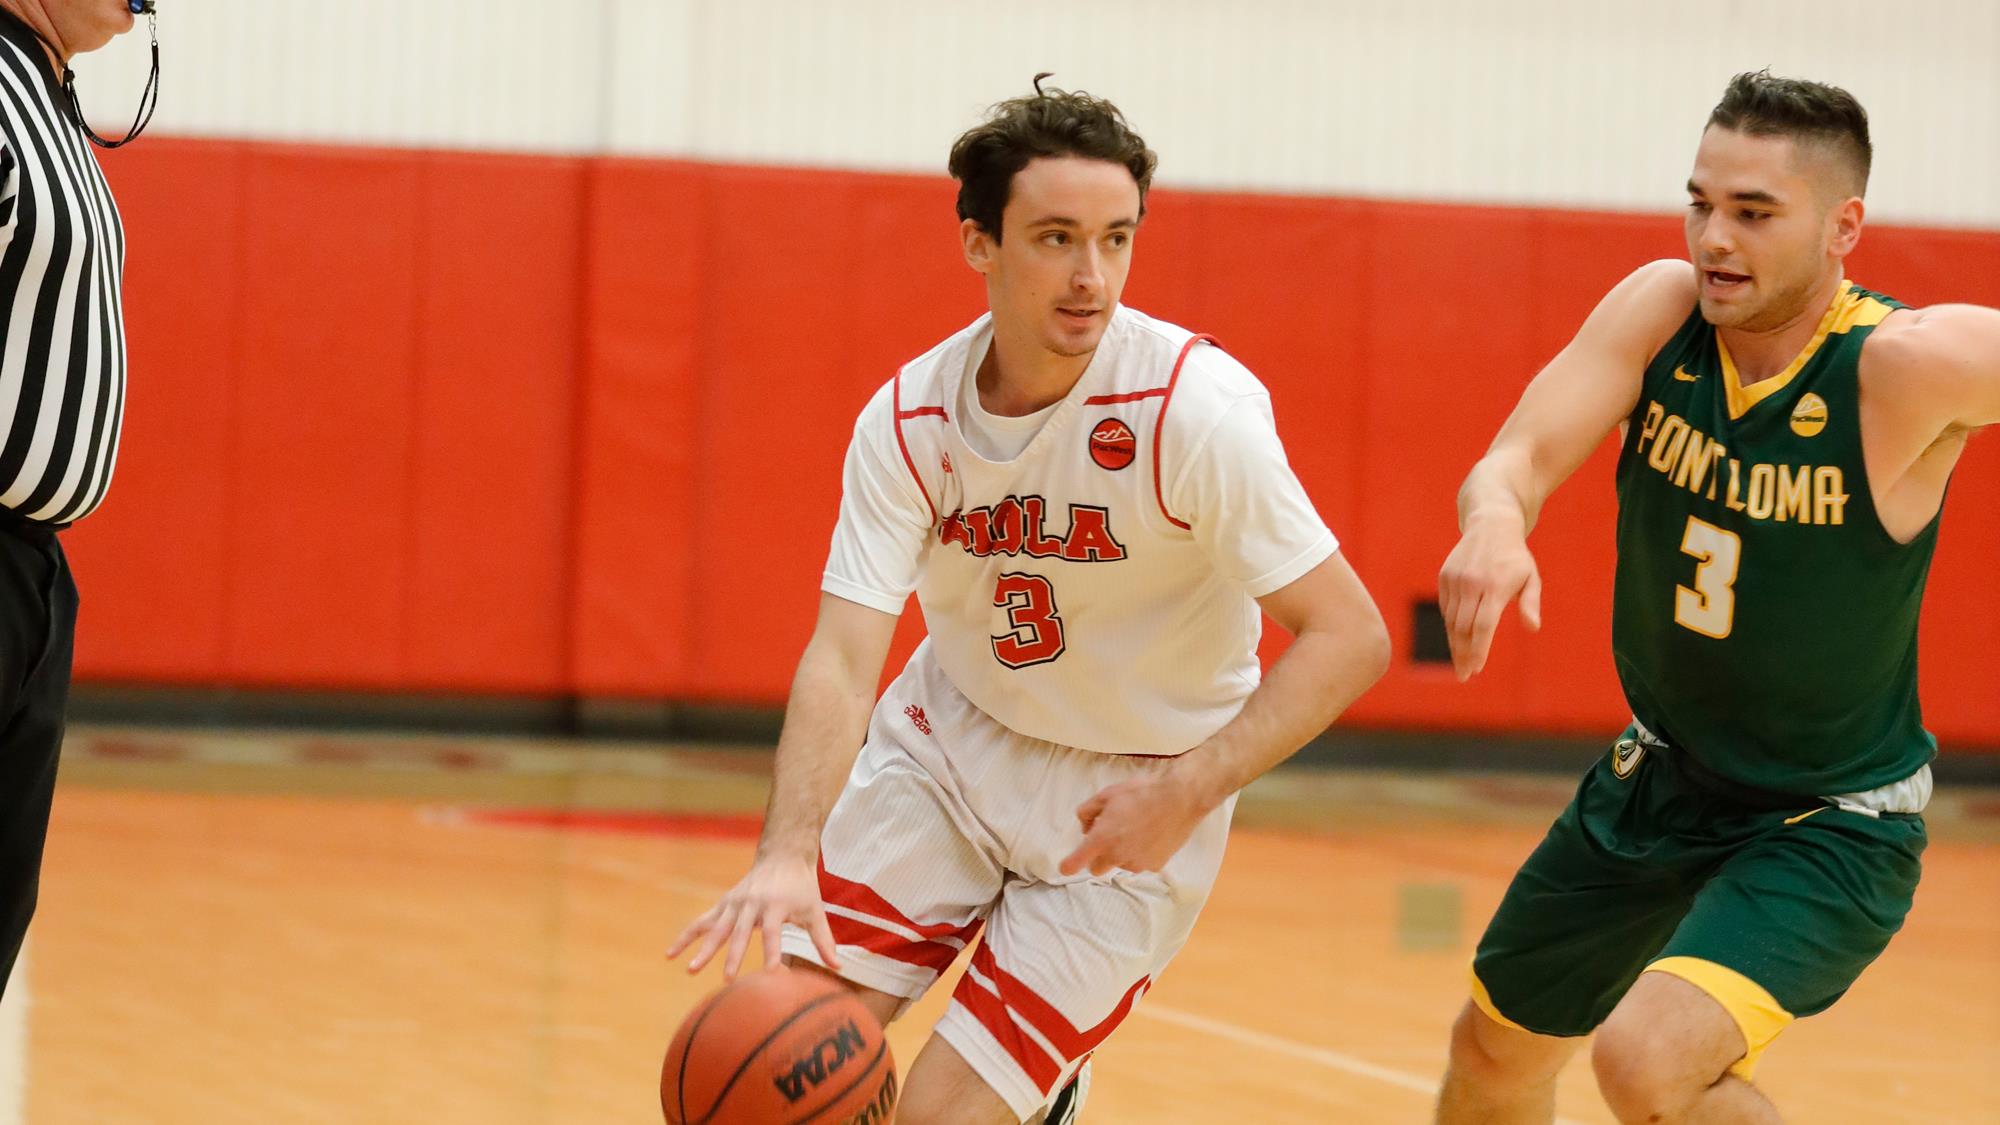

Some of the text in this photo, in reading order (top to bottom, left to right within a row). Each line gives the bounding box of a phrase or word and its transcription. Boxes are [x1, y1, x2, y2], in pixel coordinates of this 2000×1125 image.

[1725, 458, 1850, 526] LOMA
[990, 571, 1066, 671] 3
[1674, 515, 1742, 640] 3
[773, 1019, 866, 1105] NCAA
